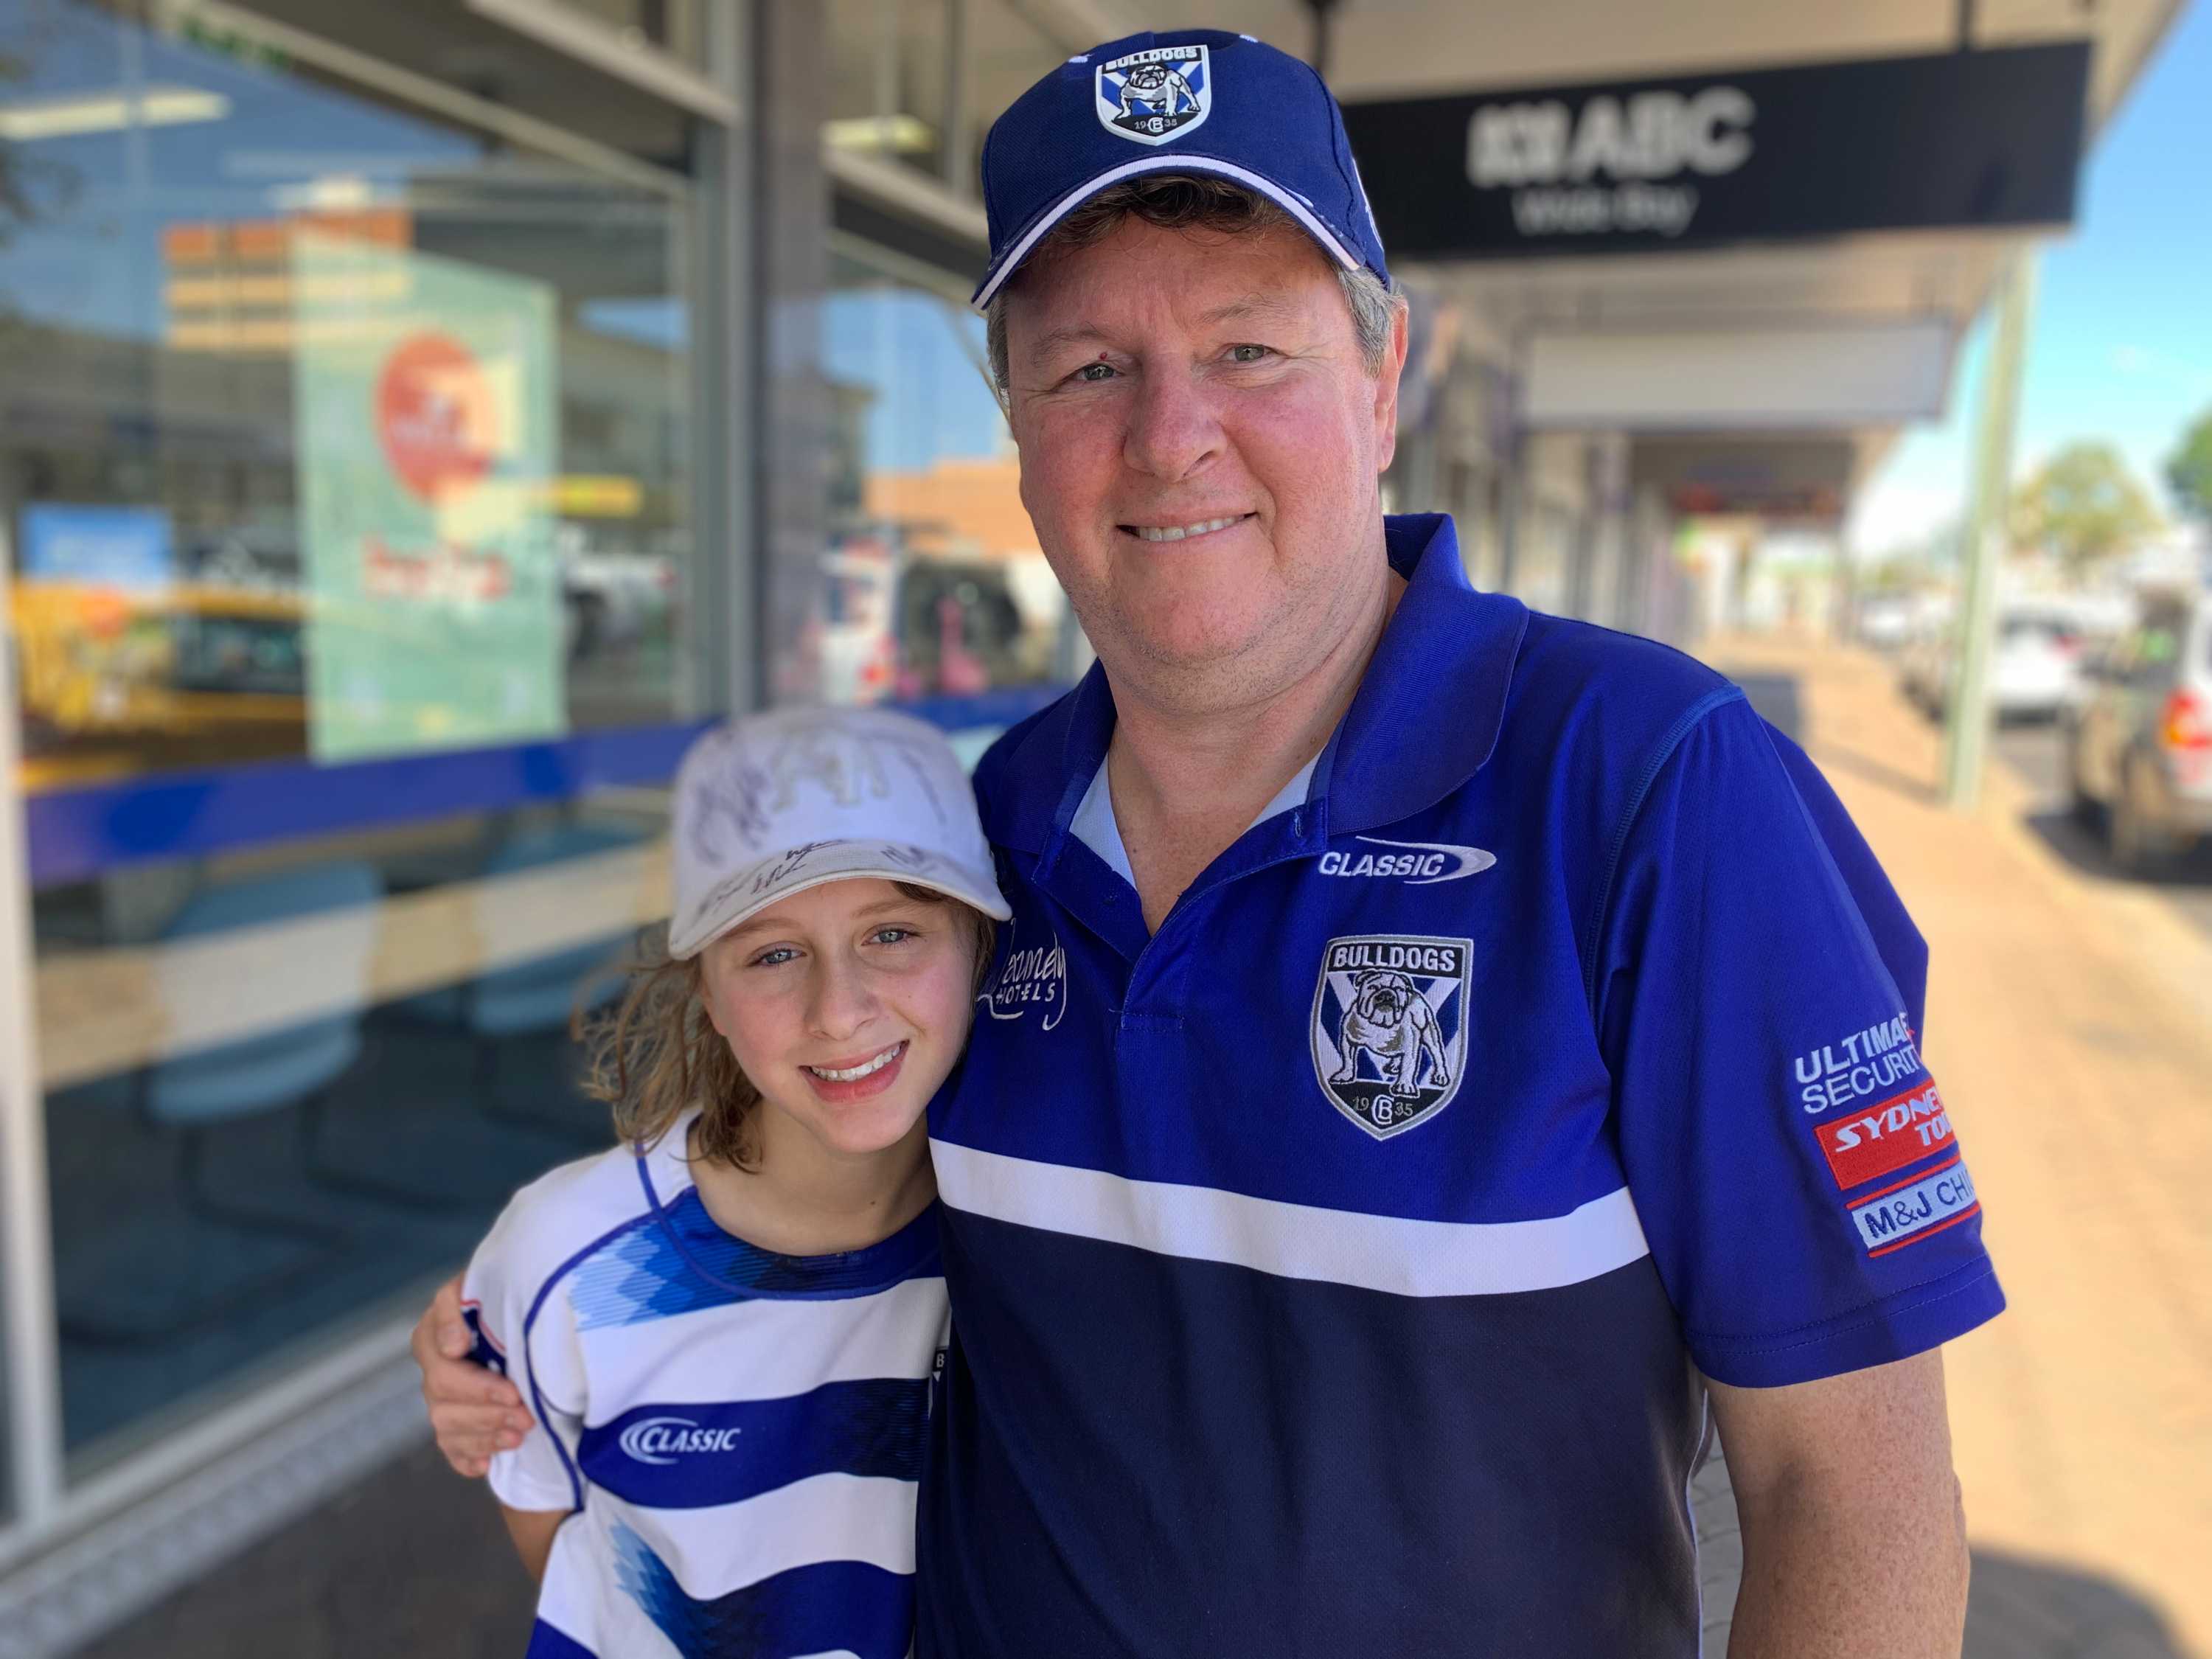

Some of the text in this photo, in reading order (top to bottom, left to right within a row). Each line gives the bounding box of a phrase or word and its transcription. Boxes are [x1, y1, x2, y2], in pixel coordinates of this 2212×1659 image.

[1568, 86, 1756, 183] ABC
[1318, 852, 1445, 877] CLASSIC
[1332, 945, 1455, 973] BULLDOGS
[995, 982, 1056, 1005] HOTELS
[1352, 1096, 1369, 1112] 19
[1394, 1102, 1413, 1117] 35
[1865, 1169, 1975, 1239] M&J CHI
[641, 1427, 741, 1453] CLASSIC
